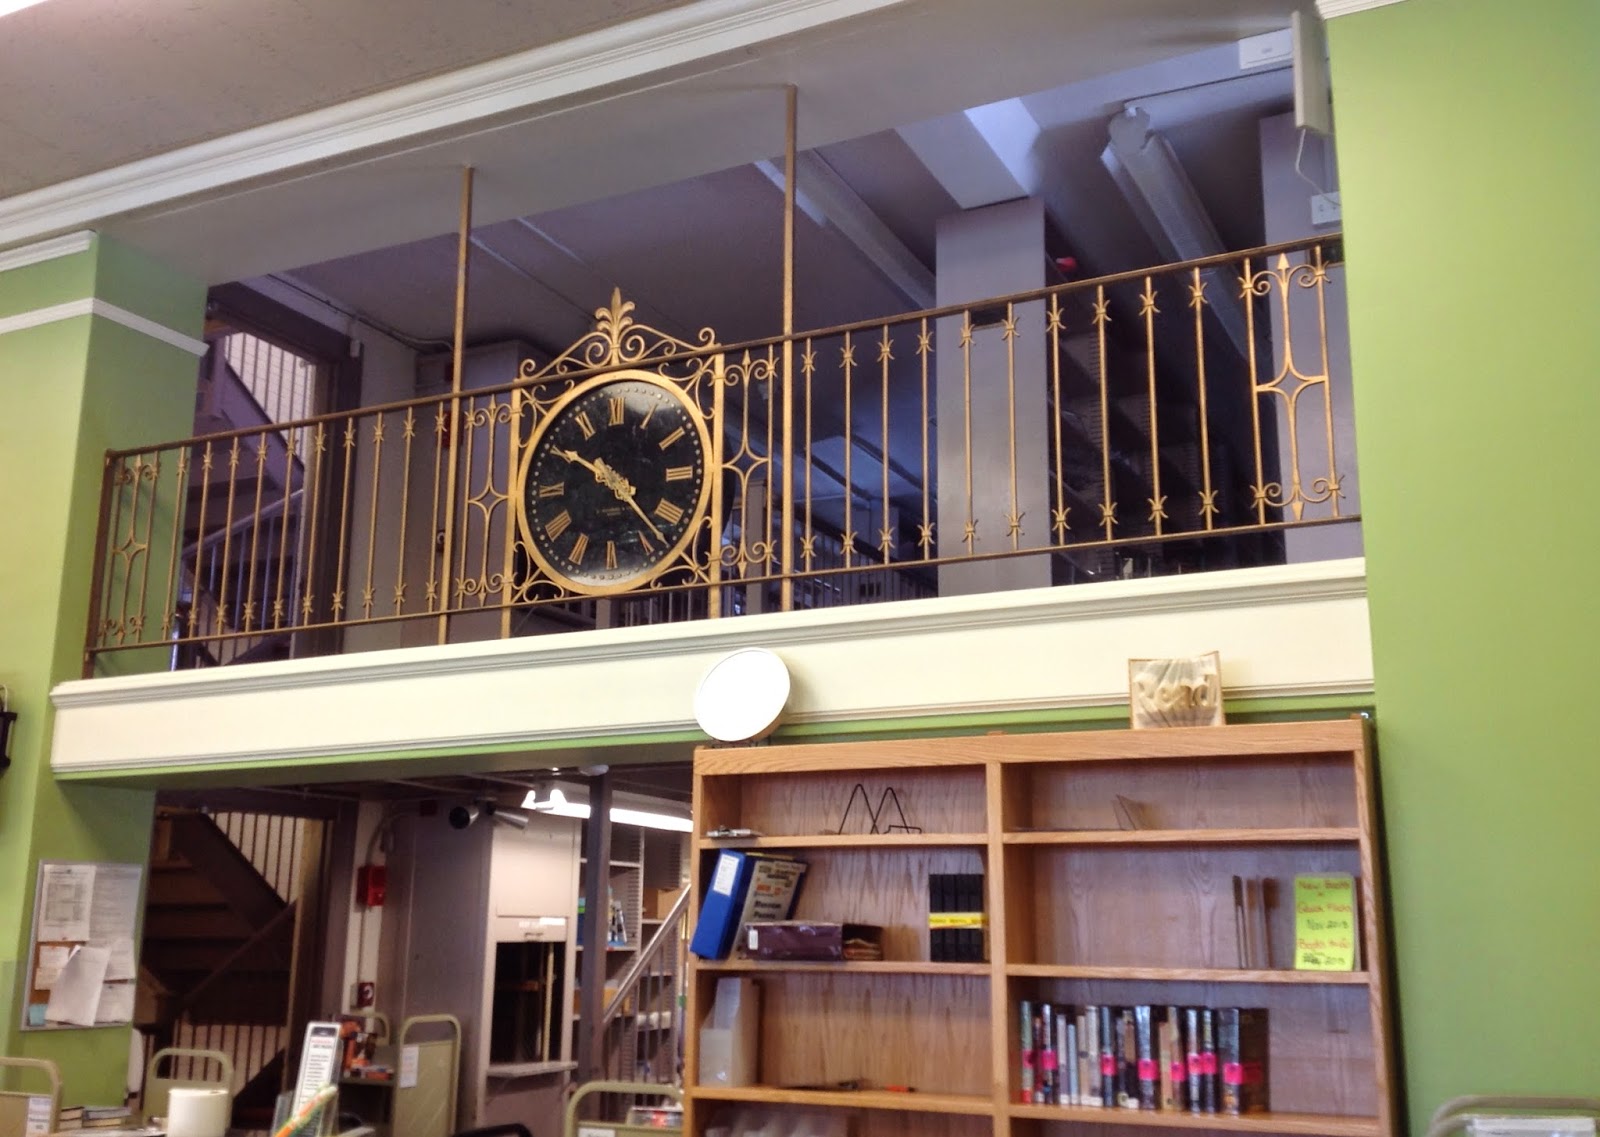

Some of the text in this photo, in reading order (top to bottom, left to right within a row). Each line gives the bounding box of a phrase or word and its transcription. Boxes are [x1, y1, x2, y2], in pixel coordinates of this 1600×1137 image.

[575, 411, 596, 441] XI
[608, 397, 625, 427] XII
[658, 426, 686, 451] II
[666, 465, 693, 482] III
[539, 482, 565, 498] IX
[654, 498, 685, 525] IIII
[544, 510, 572, 542] VIII
[568, 532, 590, 566] VII
[606, 540, 618, 570] VI
[638, 530, 655, 556] V
